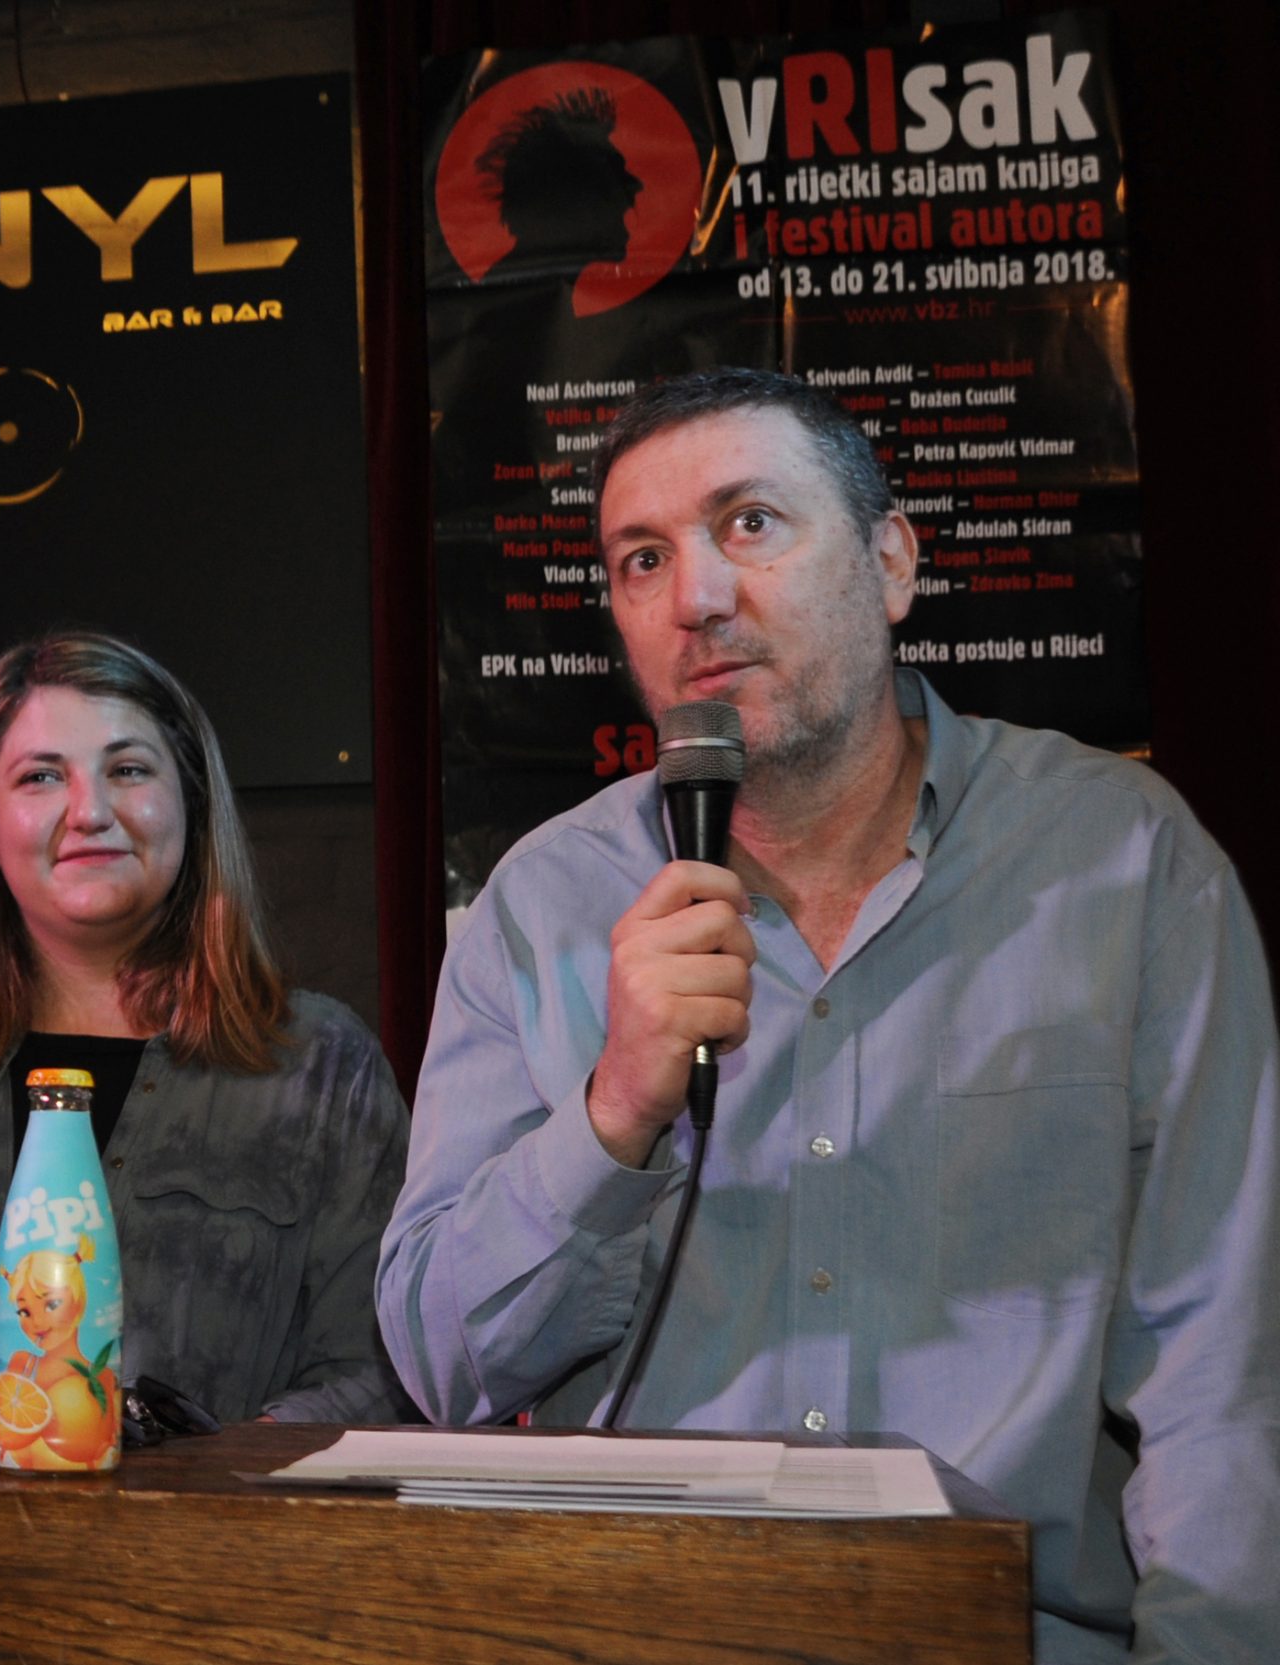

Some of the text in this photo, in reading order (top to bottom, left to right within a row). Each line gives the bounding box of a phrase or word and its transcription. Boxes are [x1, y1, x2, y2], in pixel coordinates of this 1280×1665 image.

[717, 32, 1099, 166] vRIsak
[731, 152, 1101, 208] 11. riječki sajam knjiga
[733, 199, 1104, 261] i festival autora
[737, 249, 1116, 299] od 13. do 21. svibnja 2018.
[102, 307, 173, 333] BAR
[211, 299, 284, 324] BAR
[844, 299, 996, 325] www.vbz.hr
[806, 366, 870, 387] Selvedin
[874, 364, 914, 384] Avdić
[526, 382, 559, 402] Neal
[563, 379, 636, 400] Ascherson
[910, 389, 962, 409] Dražen
[965, 386, 1017, 407] Cuculić
[913, 442, 956, 463] Petra
[959, 440, 1017, 461] Kapović
[1019, 438, 1076, 458] Vidmar
[494, 462, 535, 481] Zoran
[494, 514, 538, 533] Darko
[955, 520, 1018, 540] Abdulah
[1022, 518, 1072, 537] Sidran
[503, 541, 548, 559] Marko
[544, 565, 585, 584] Vlado
[1036, 571, 1075, 590] Zima
[955, 636, 1026, 664] gostuje
[1031, 637, 1044, 658] u
[1050, 632, 1104, 660] Rijeci
[481, 653, 610, 678] EPK na Vrisku
